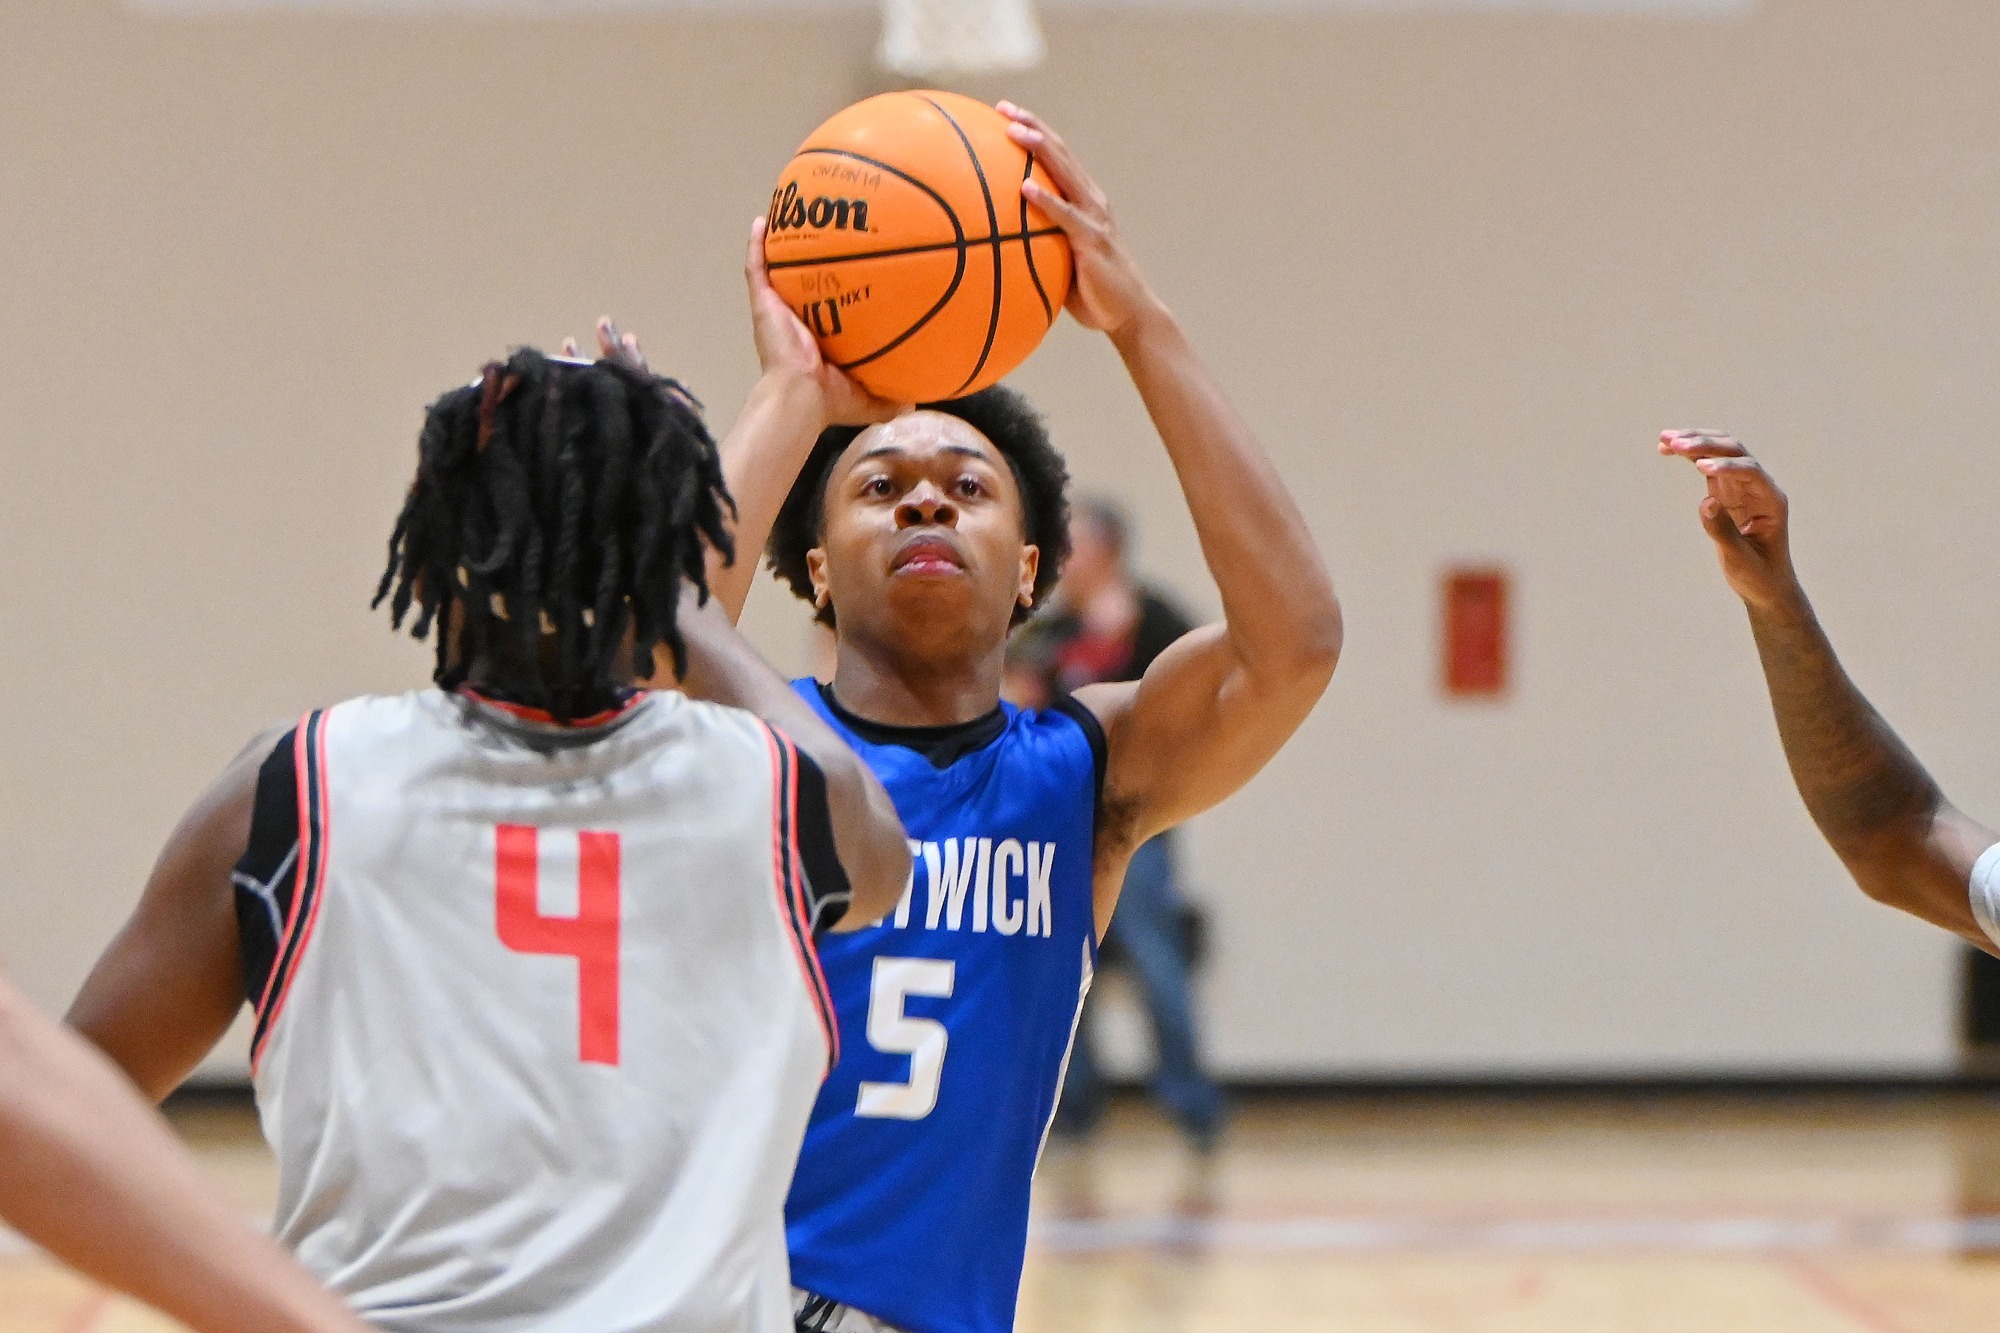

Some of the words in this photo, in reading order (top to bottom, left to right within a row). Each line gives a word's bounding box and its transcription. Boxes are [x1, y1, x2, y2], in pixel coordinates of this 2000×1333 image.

[495, 823, 620, 1067] 4
[872, 837, 1056, 938] TWICK
[853, 955, 955, 1120] 5
